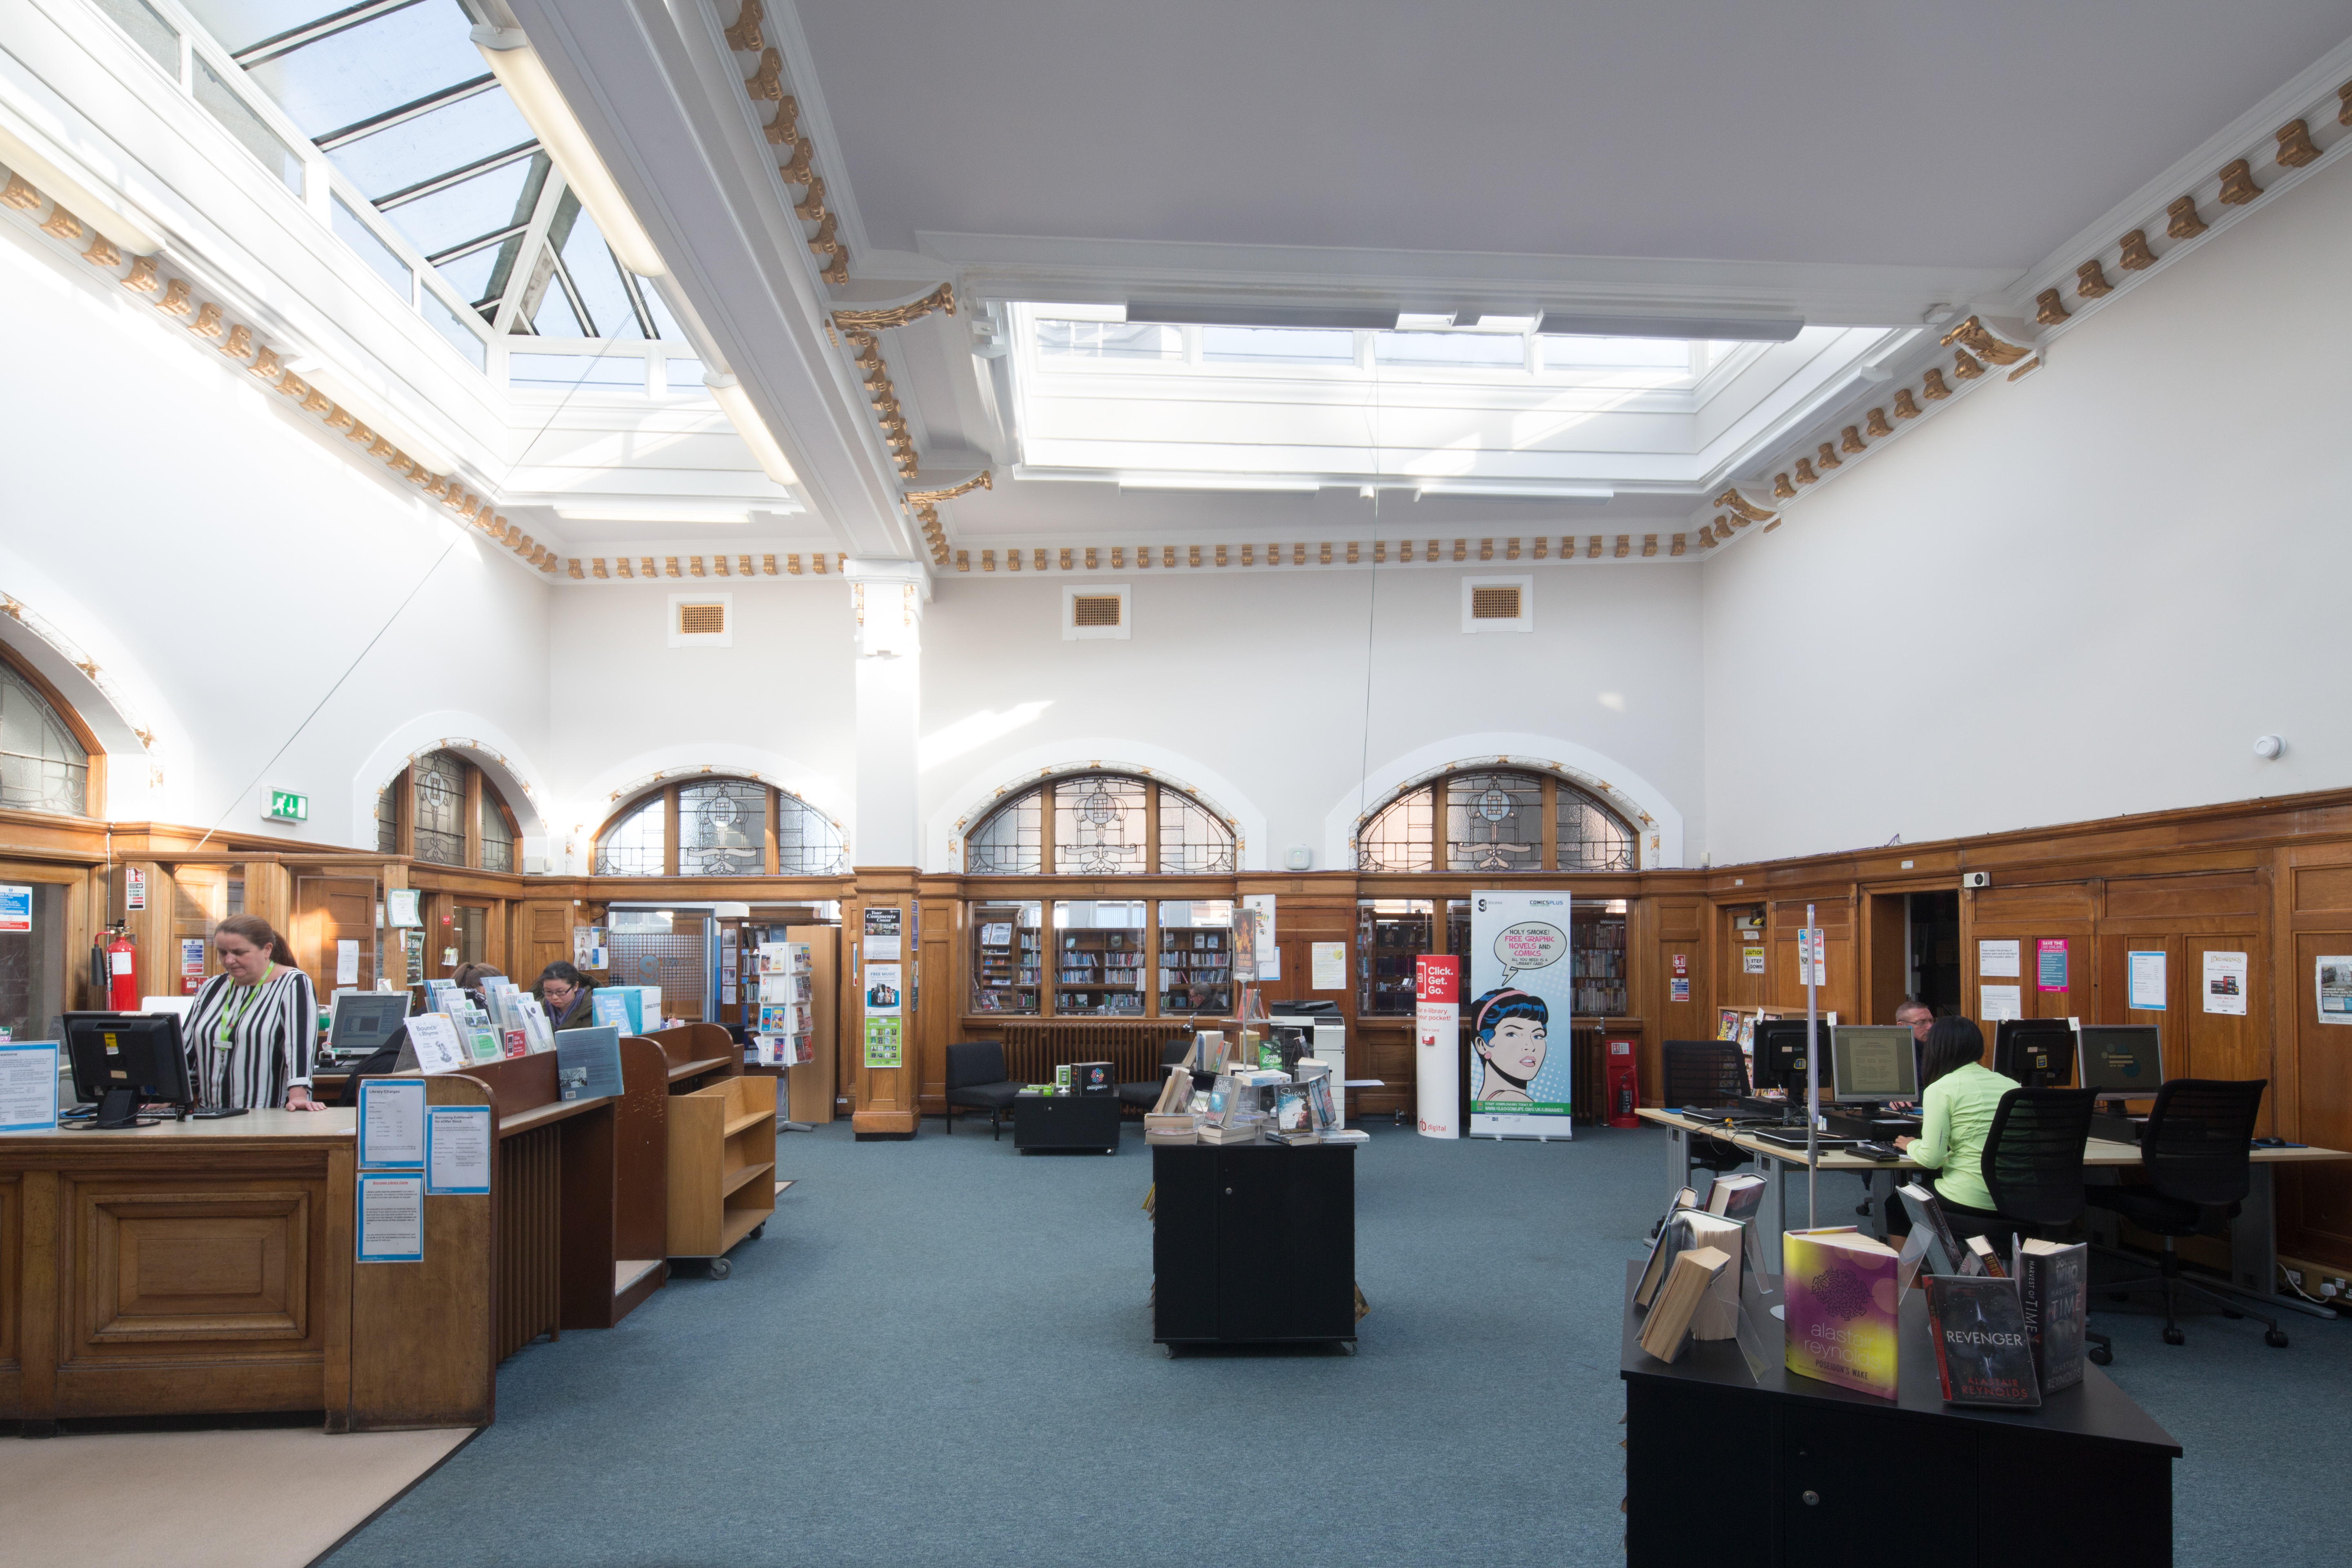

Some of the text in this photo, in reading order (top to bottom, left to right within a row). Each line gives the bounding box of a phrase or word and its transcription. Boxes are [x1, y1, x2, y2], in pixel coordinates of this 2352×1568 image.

[1428, 967, 1453, 975] Click.
[1428, 976, 1447, 984] Get.
[1428, 986, 1443, 994] Go.
[1280, 1088, 1307, 1098] Susan
[1205, 1111, 1224, 1120] PIRATE
[1428, 1124, 1446, 1132] digital
[2029, 1291, 2034, 1299] OF
[2051, 1281, 2082, 1297] HARVEST OF
[2051, 1292, 2081, 1320] TIME
[2025, 1301, 2038, 1332] TIME
[1811, 1323, 1875, 1349] alastair
[1947, 1331, 2023, 1346] REVENGER
[1804, 1339, 1881, 1370] reynolds
[1815, 1359, 1850, 1375] POSEIDON'S
[1852, 1368, 1869, 1380] WAKE
[1967, 1377, 2018, 1387] ALASTAIR
[2047, 1366, 2081, 1390] REYNOLDS
[1962, 1385, 2028, 1398] REYNOLDS
